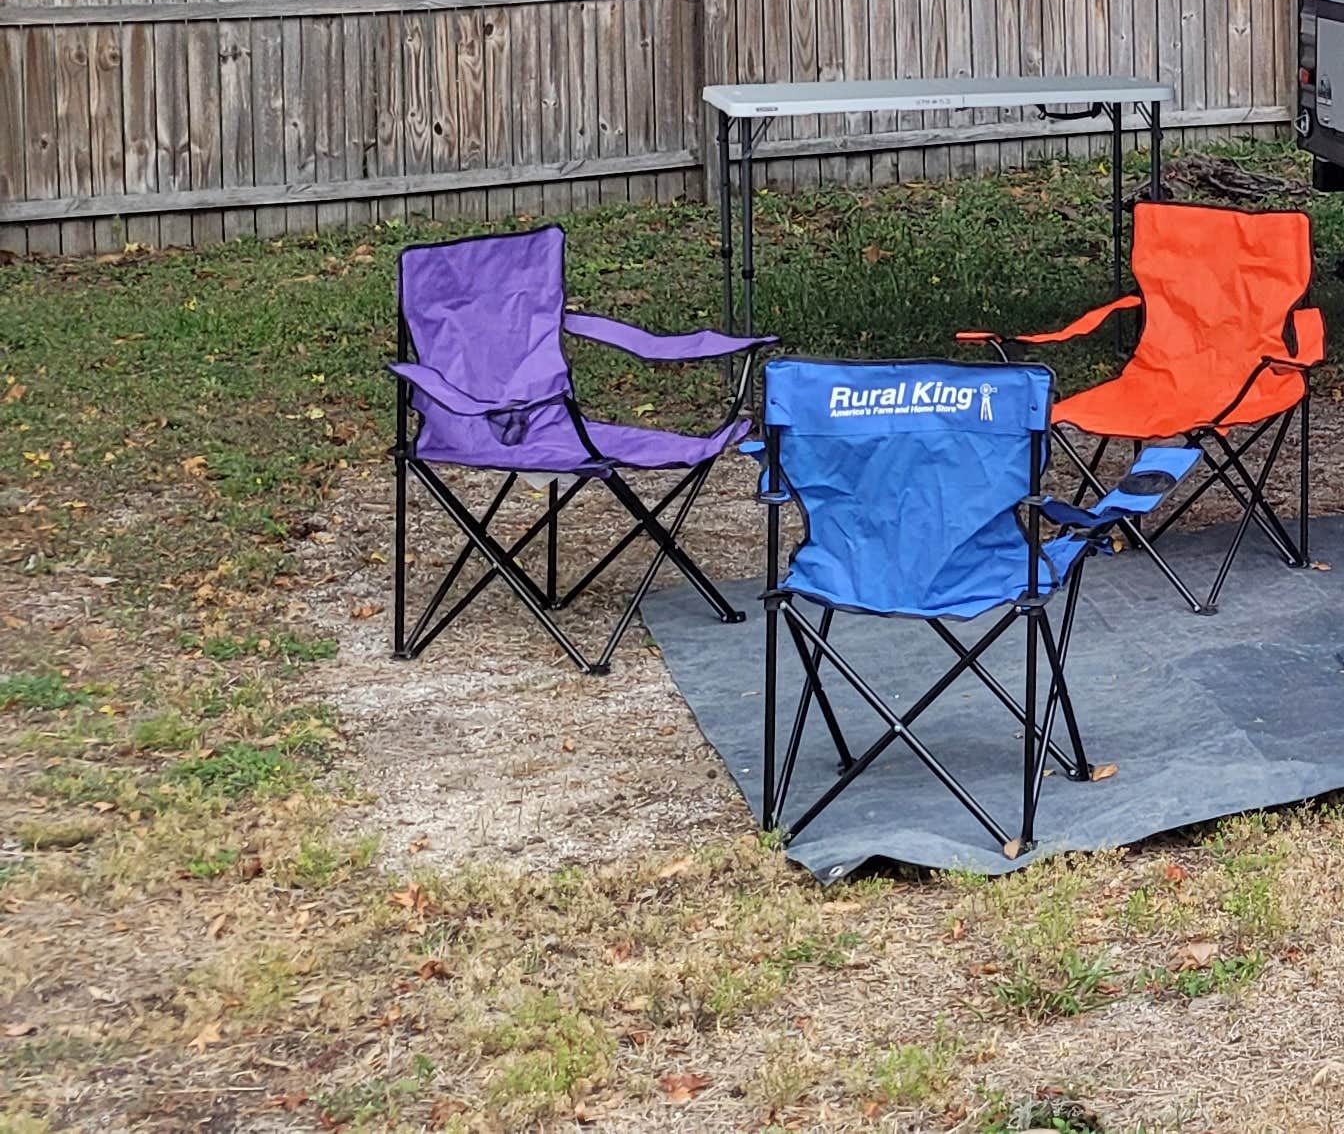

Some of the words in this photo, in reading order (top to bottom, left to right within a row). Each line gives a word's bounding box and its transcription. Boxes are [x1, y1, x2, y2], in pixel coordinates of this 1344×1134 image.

[830, 382, 905, 409] Rural
[912, 381, 974, 410] King
[873, 406, 894, 415] Farm
[895, 405, 909, 414] and
[910, 405, 934, 414] Home
